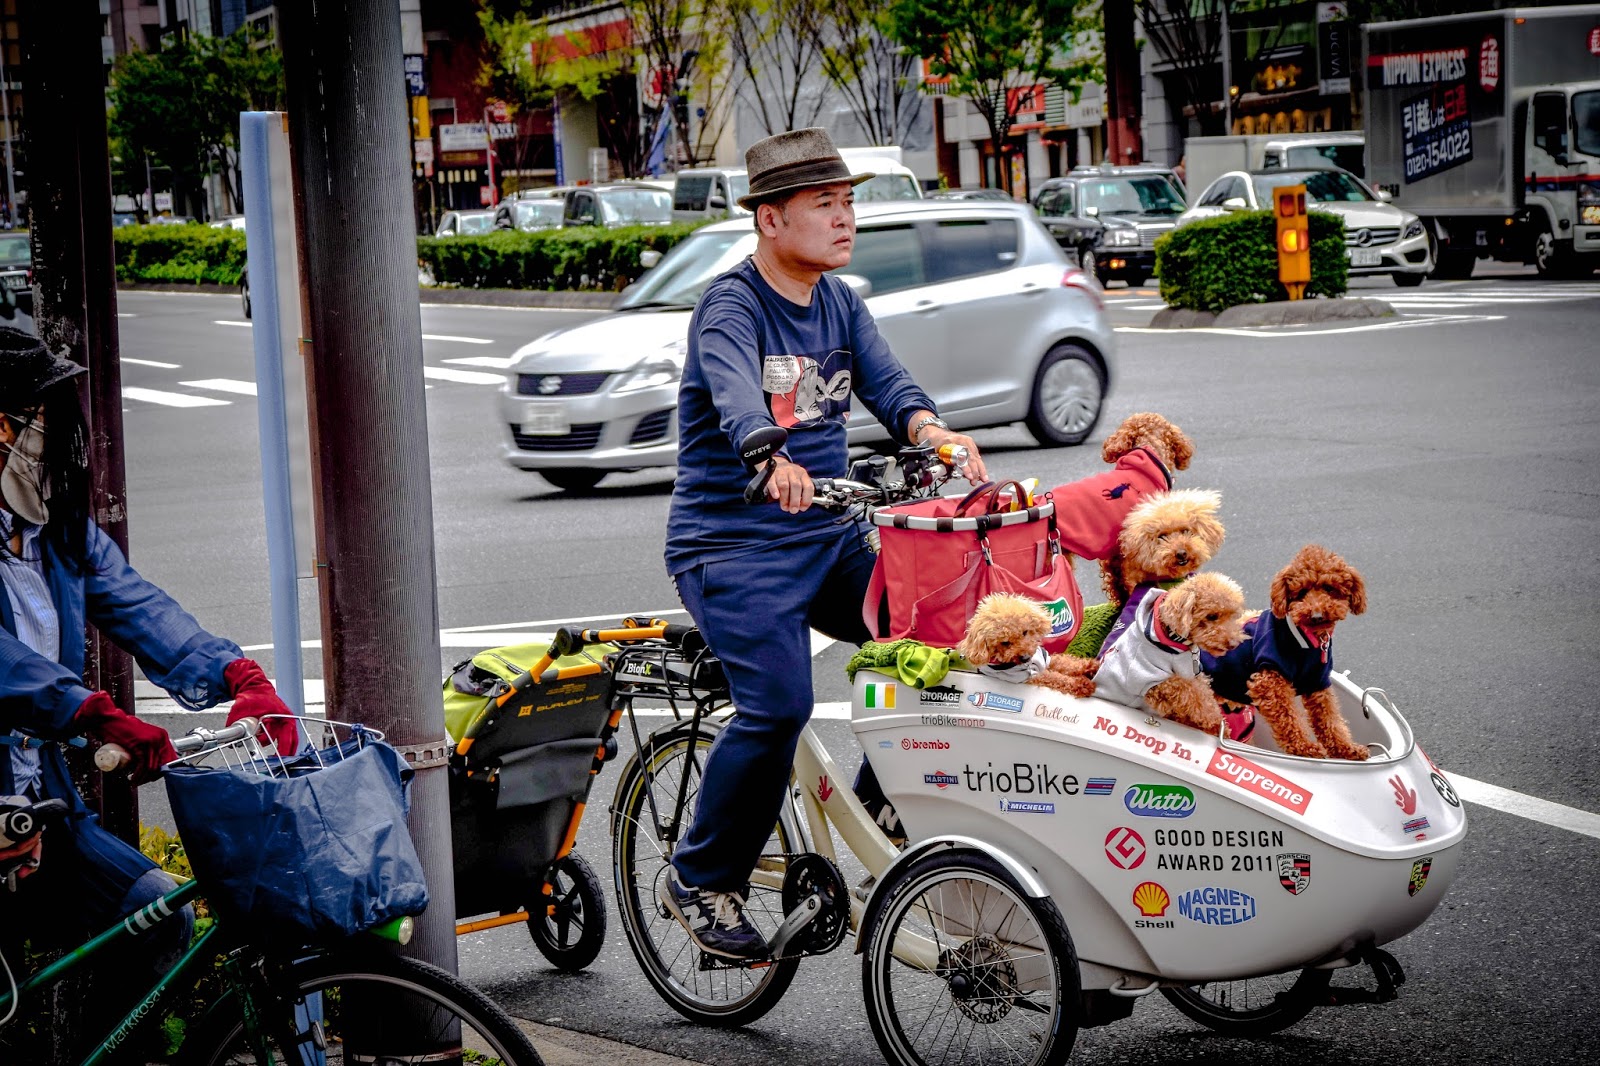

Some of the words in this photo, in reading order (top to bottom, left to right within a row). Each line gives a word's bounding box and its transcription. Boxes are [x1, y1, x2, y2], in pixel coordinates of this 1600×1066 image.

[1383, 54, 1420, 86] NIPPON
[1422, 49, 1466, 82] EXPRESS
[744, 443, 771, 458] CATEYE
[921, 690, 960, 702] STORAGE
[988, 694, 1022, 708] STORAGE
[1034, 703, 1062, 720] Chill
[1062, 713, 1080, 724] out
[912, 739, 950, 749] brembo
[1093, 716, 1119, 736] No
[1123, 725, 1167, 756] Drop
[925, 776, 958, 784] MARTINI
[963, 762, 1079, 796] trioBike
[1214, 753, 1304, 806] Supreme
[1010, 803, 1053, 811] MICHELIN
[1126, 786, 1194, 812] Watts
[1155, 829, 1205, 847] GOOD
[1212, 830, 1284, 848] DESIGN
[1157, 854, 1224, 871] AWARD
[1231, 855, 1273, 872] 2011
[1178, 887, 1256, 912] MAGNETI
[681, 904, 709, 930] N
[1135, 920, 1174, 929] Shell
